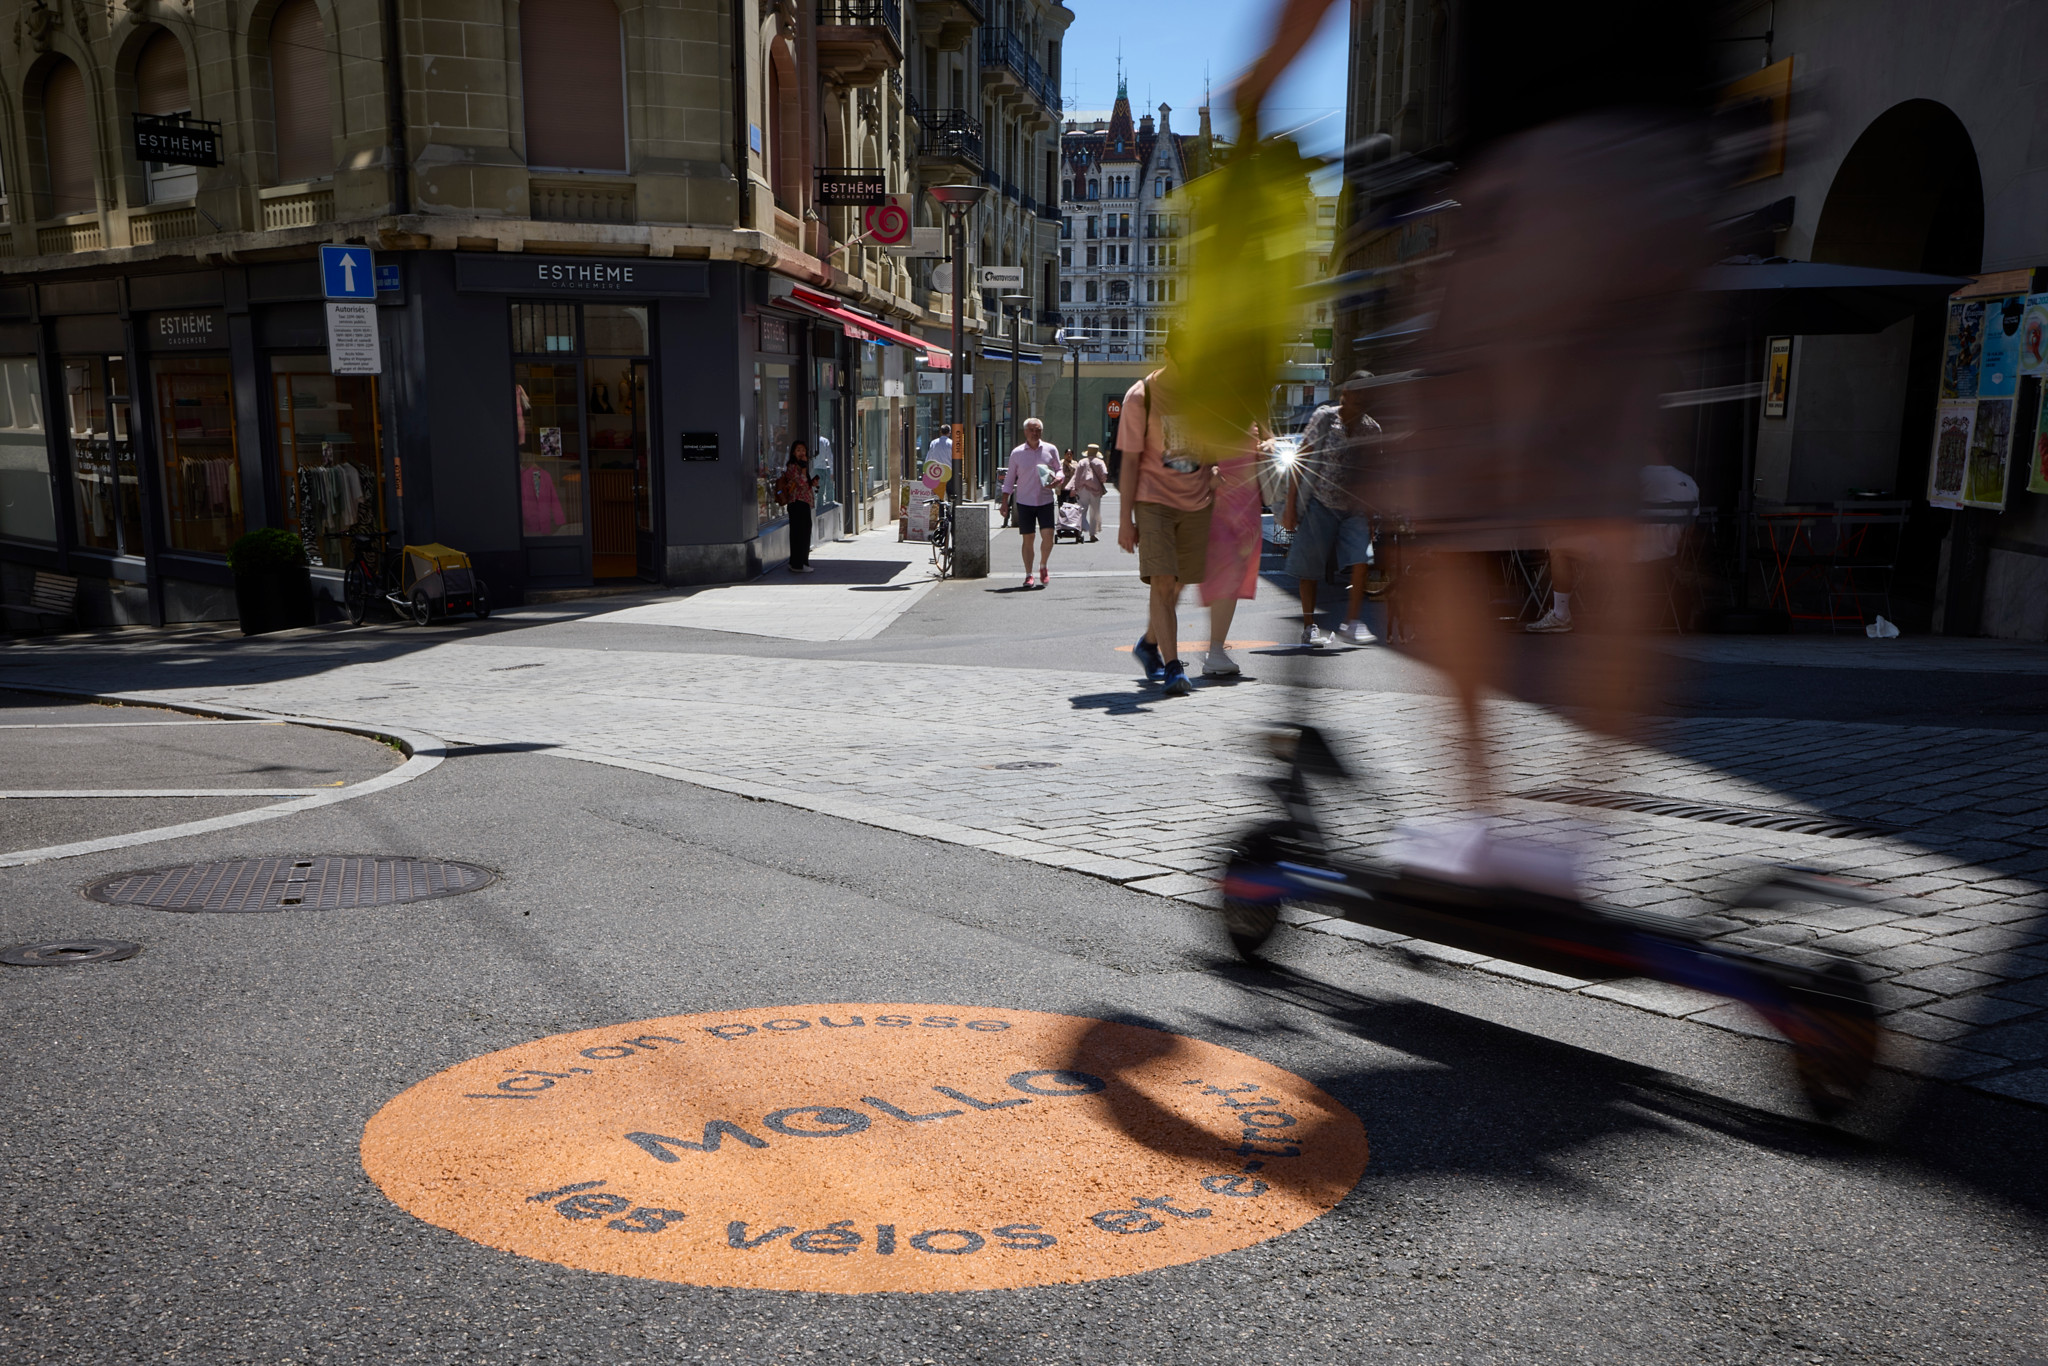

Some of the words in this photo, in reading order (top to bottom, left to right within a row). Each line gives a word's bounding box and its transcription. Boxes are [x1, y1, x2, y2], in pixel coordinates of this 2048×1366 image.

[551, 281, 621, 290] CACHEMIRE
[335, 305, 366, 313] Autorisés
[1108, 402, 1120, 413] ria
[465, 1065, 593, 1100] Ici,
[579, 1032, 686, 1061] on
[702, 1013, 1011, 1041] pousse
[624, 1068, 1106, 1163] MOLLO
[525, 1179, 687, 1235] les
[727, 1218, 1059, 1256] vélos
[1089, 1195, 1213, 1235] et
